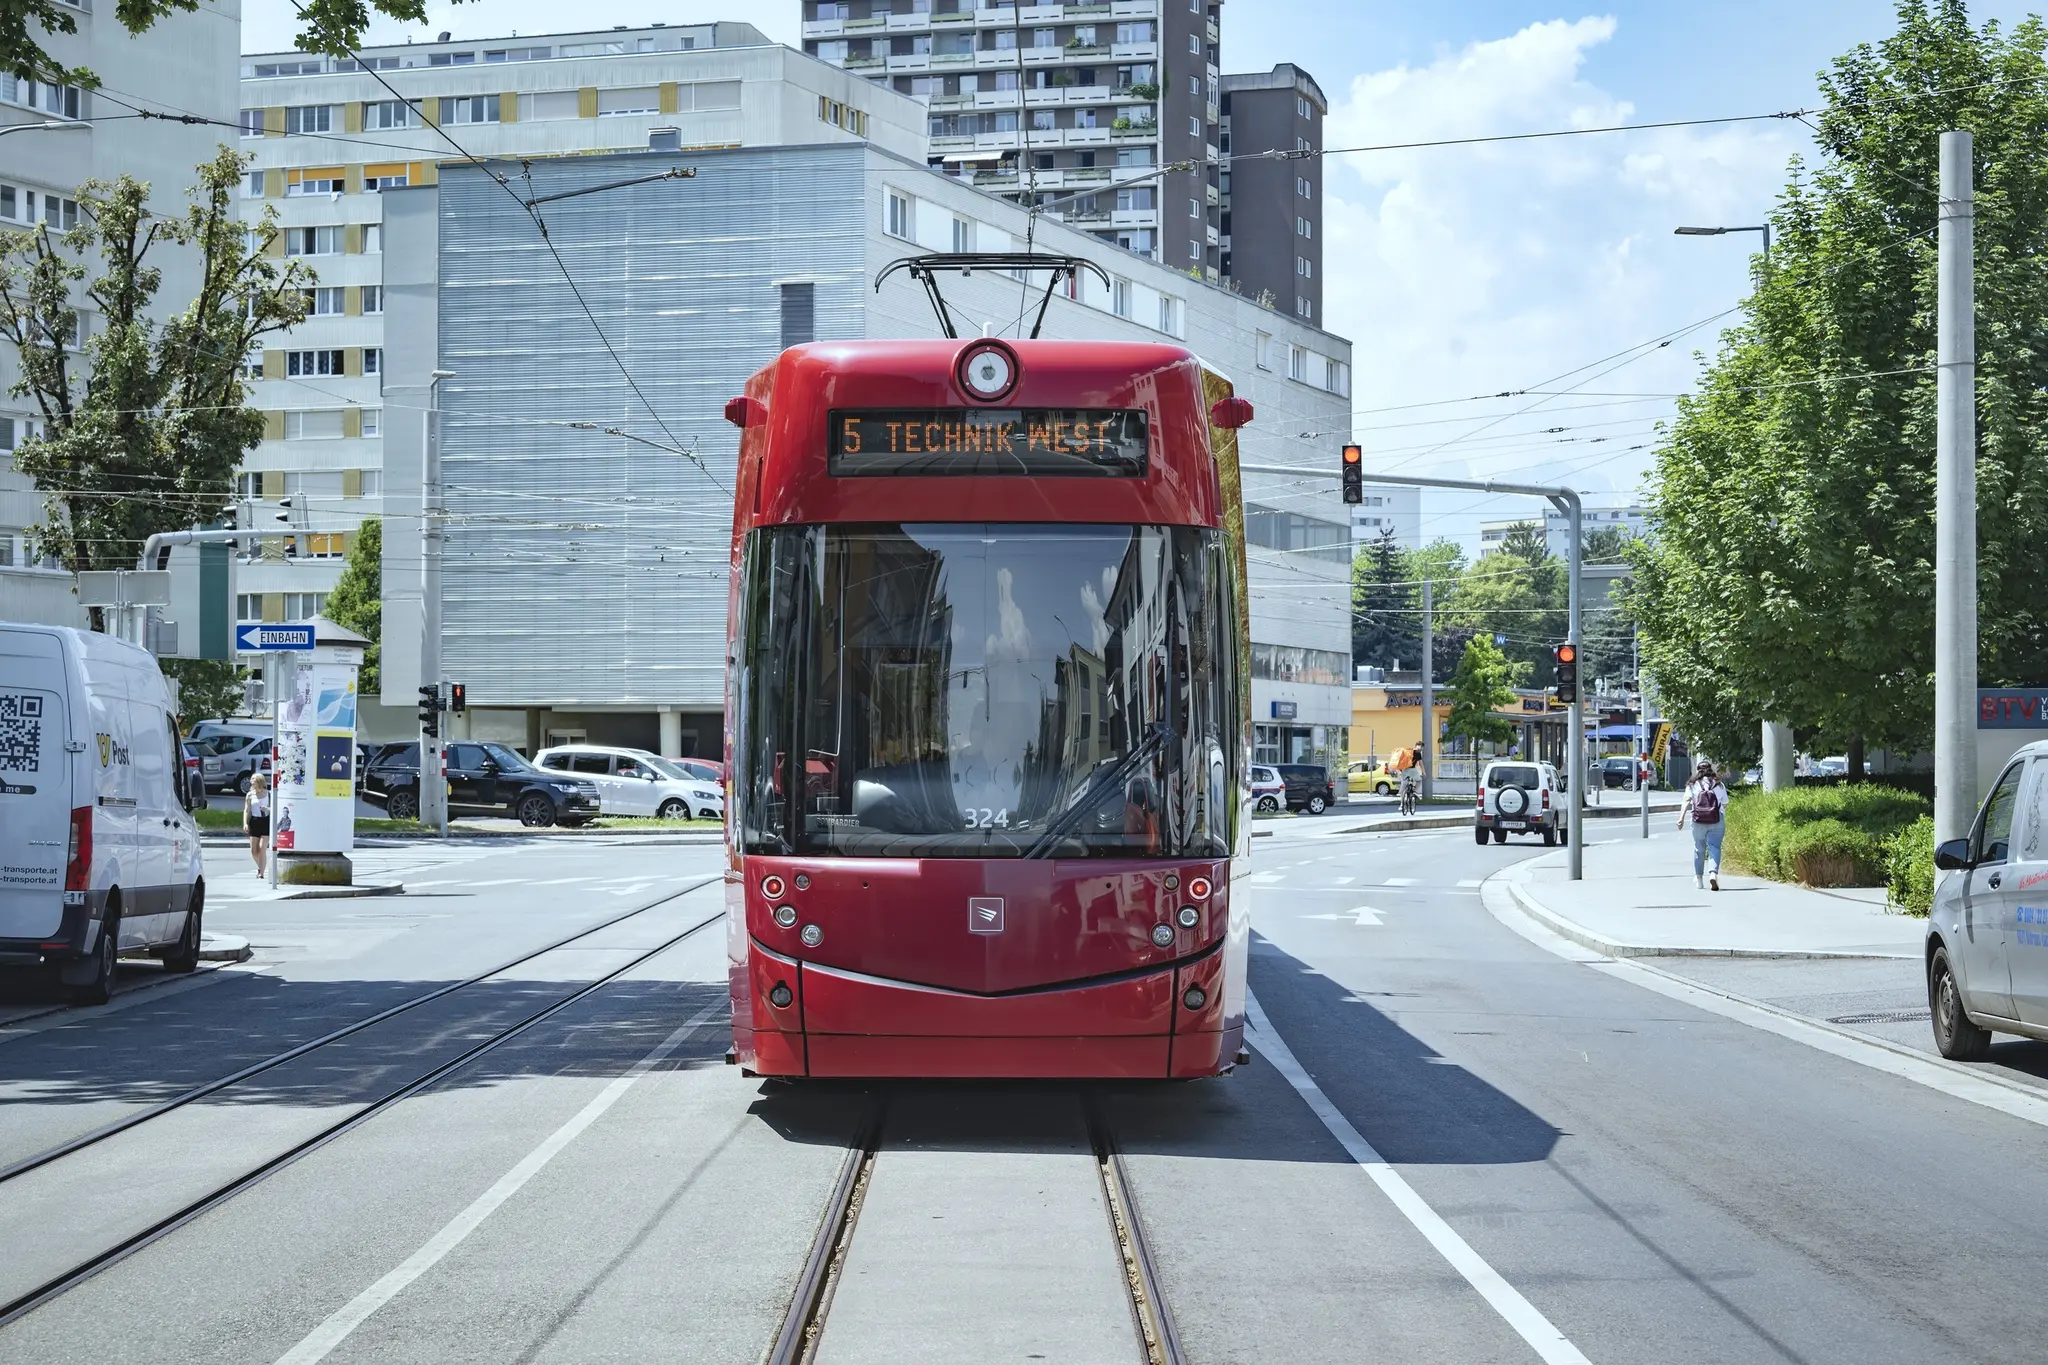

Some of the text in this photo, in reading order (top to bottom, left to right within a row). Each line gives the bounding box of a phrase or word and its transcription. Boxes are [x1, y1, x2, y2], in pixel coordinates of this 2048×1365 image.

[844, 418, 1109, 453] 5 TECHNIK WEST
[260, 632, 306, 643] EINBAHN
[1386, 694, 1459, 708] ADMRA
[2041, 697, 2048, 705] V
[1981, 697, 2039, 720] BTV
[2041, 705, 2048, 713] L
[2041, 712, 2048, 720] B
[112, 740, 130, 766] Post
[1655, 728, 1671, 764] DMIRAL
[5, 786, 21, 794] me
[964, 807, 1009, 828] 324
